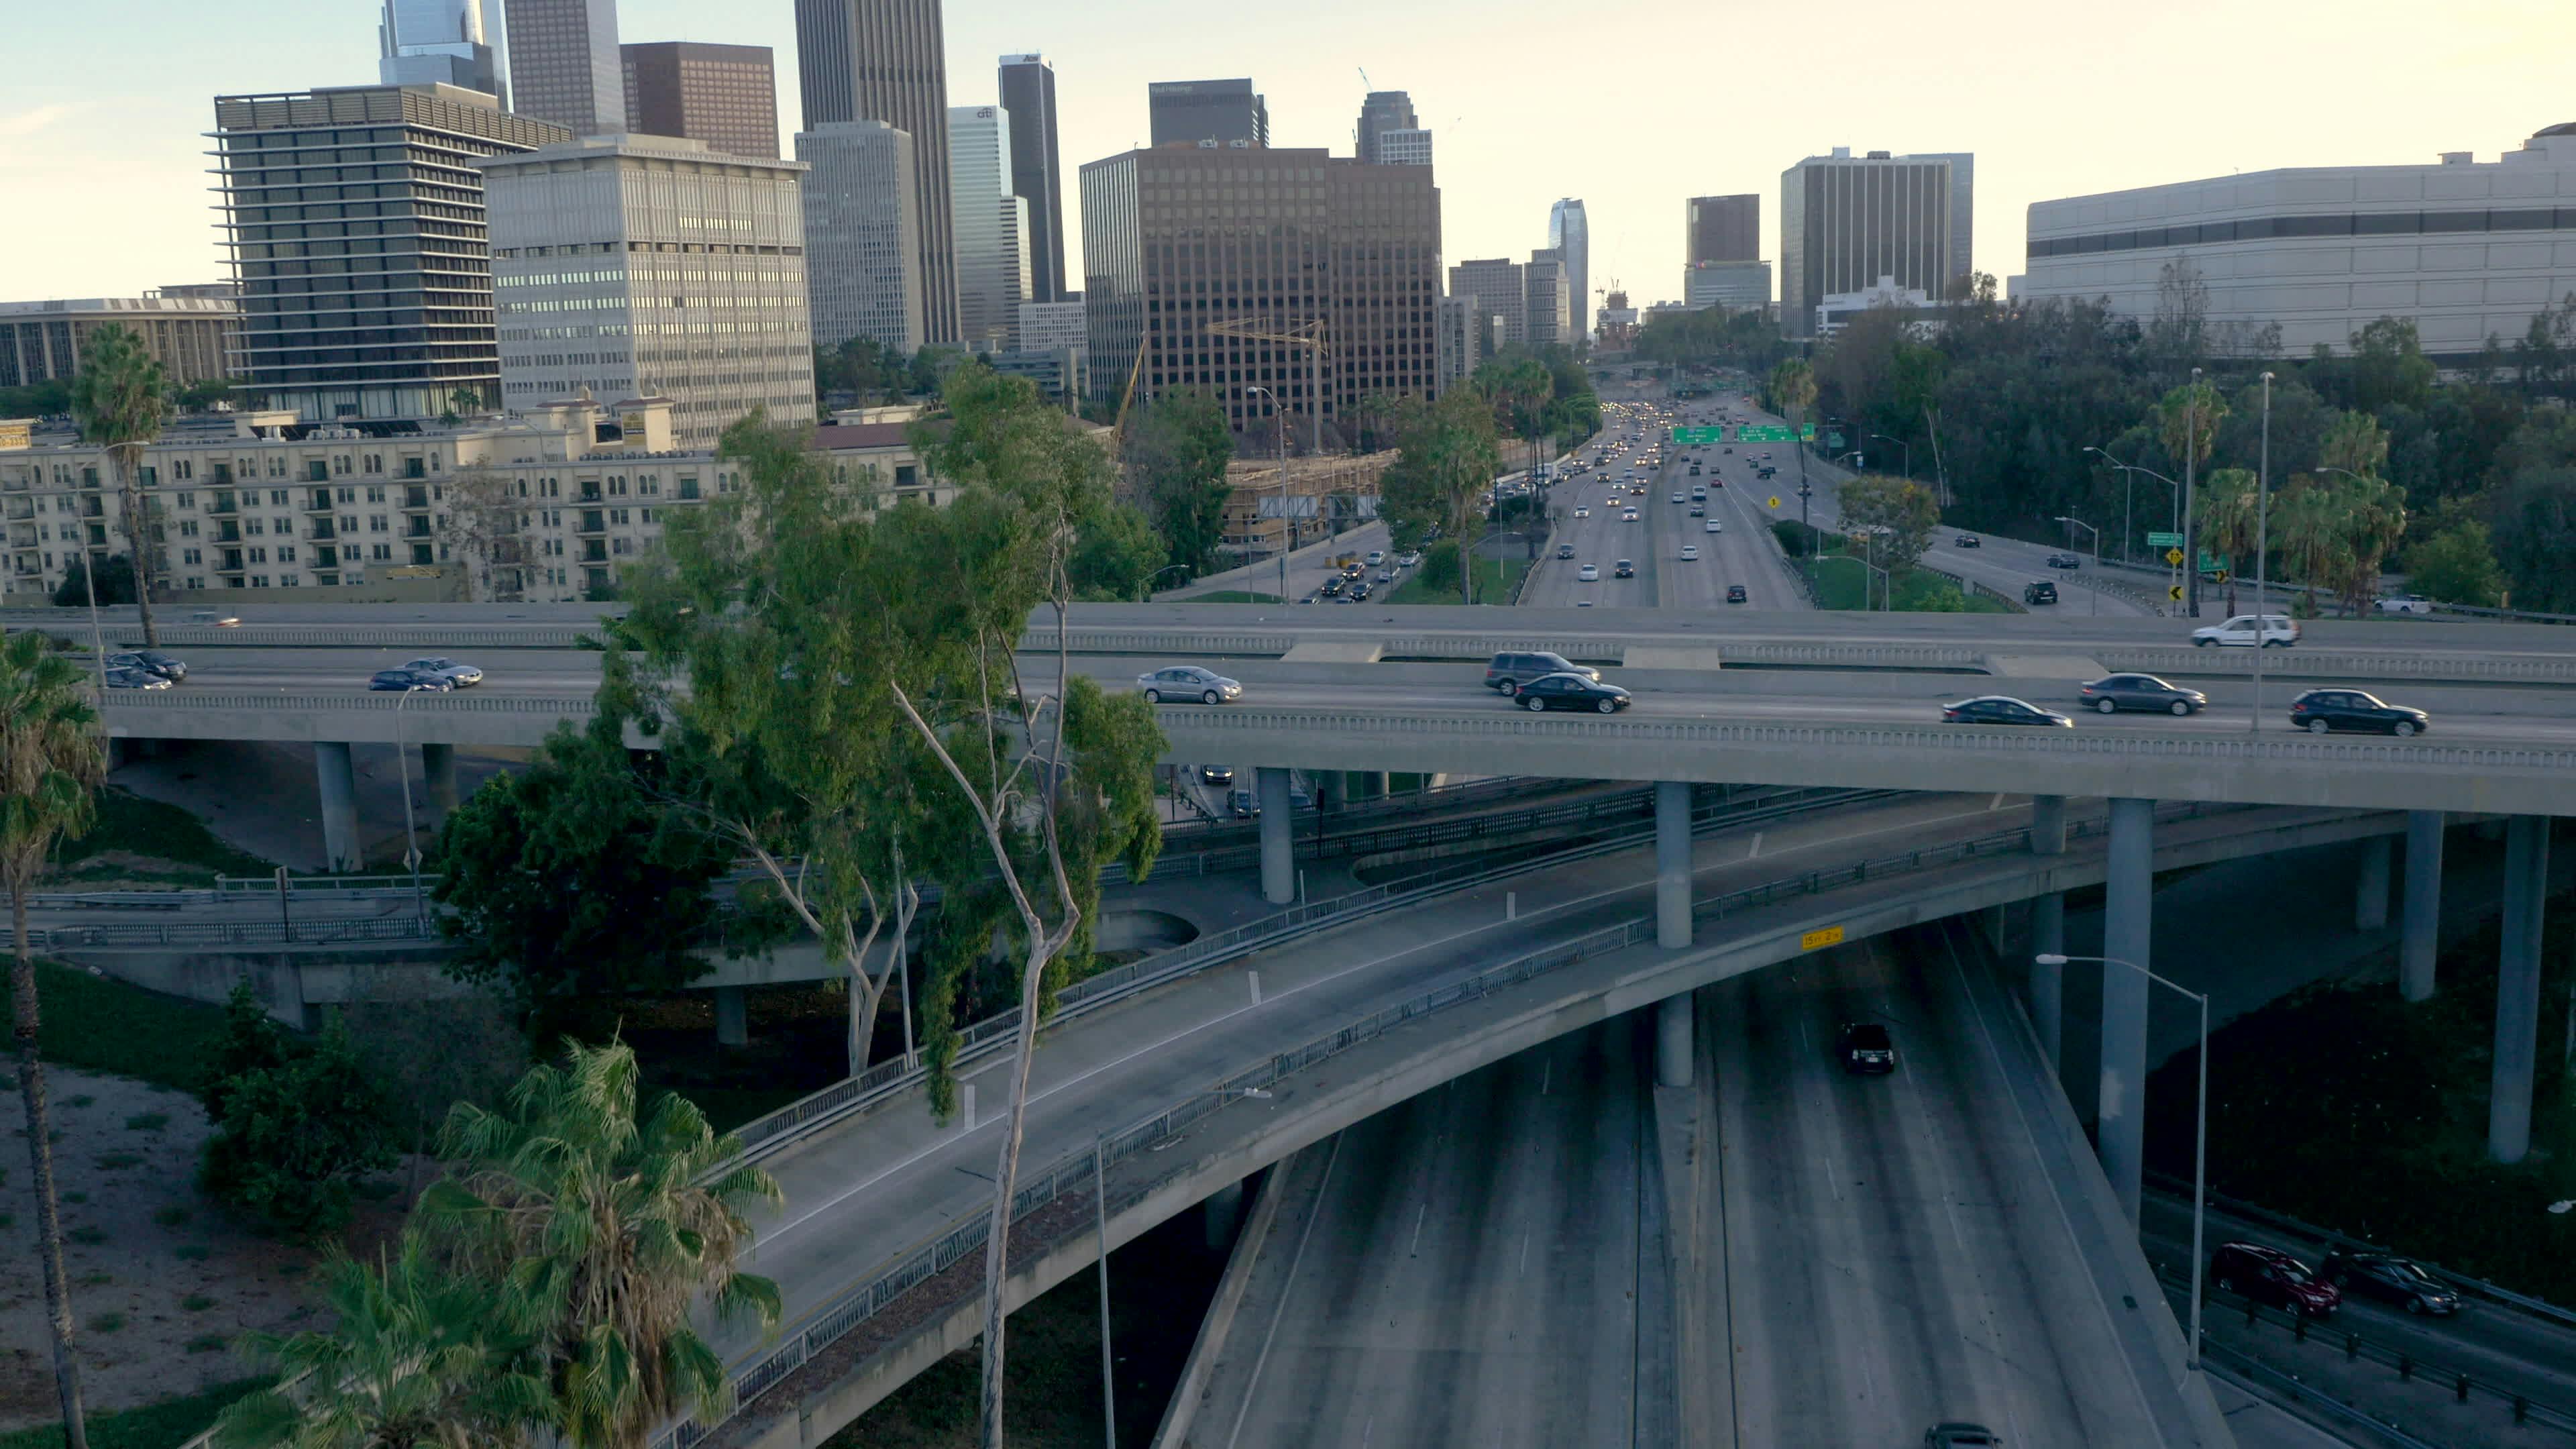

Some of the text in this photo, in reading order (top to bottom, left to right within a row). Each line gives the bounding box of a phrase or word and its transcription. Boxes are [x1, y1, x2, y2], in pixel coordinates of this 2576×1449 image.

[977, 107, 992, 118] citi
[1805, 935, 1813, 945] 15
[1825, 931, 1831, 941] 2
